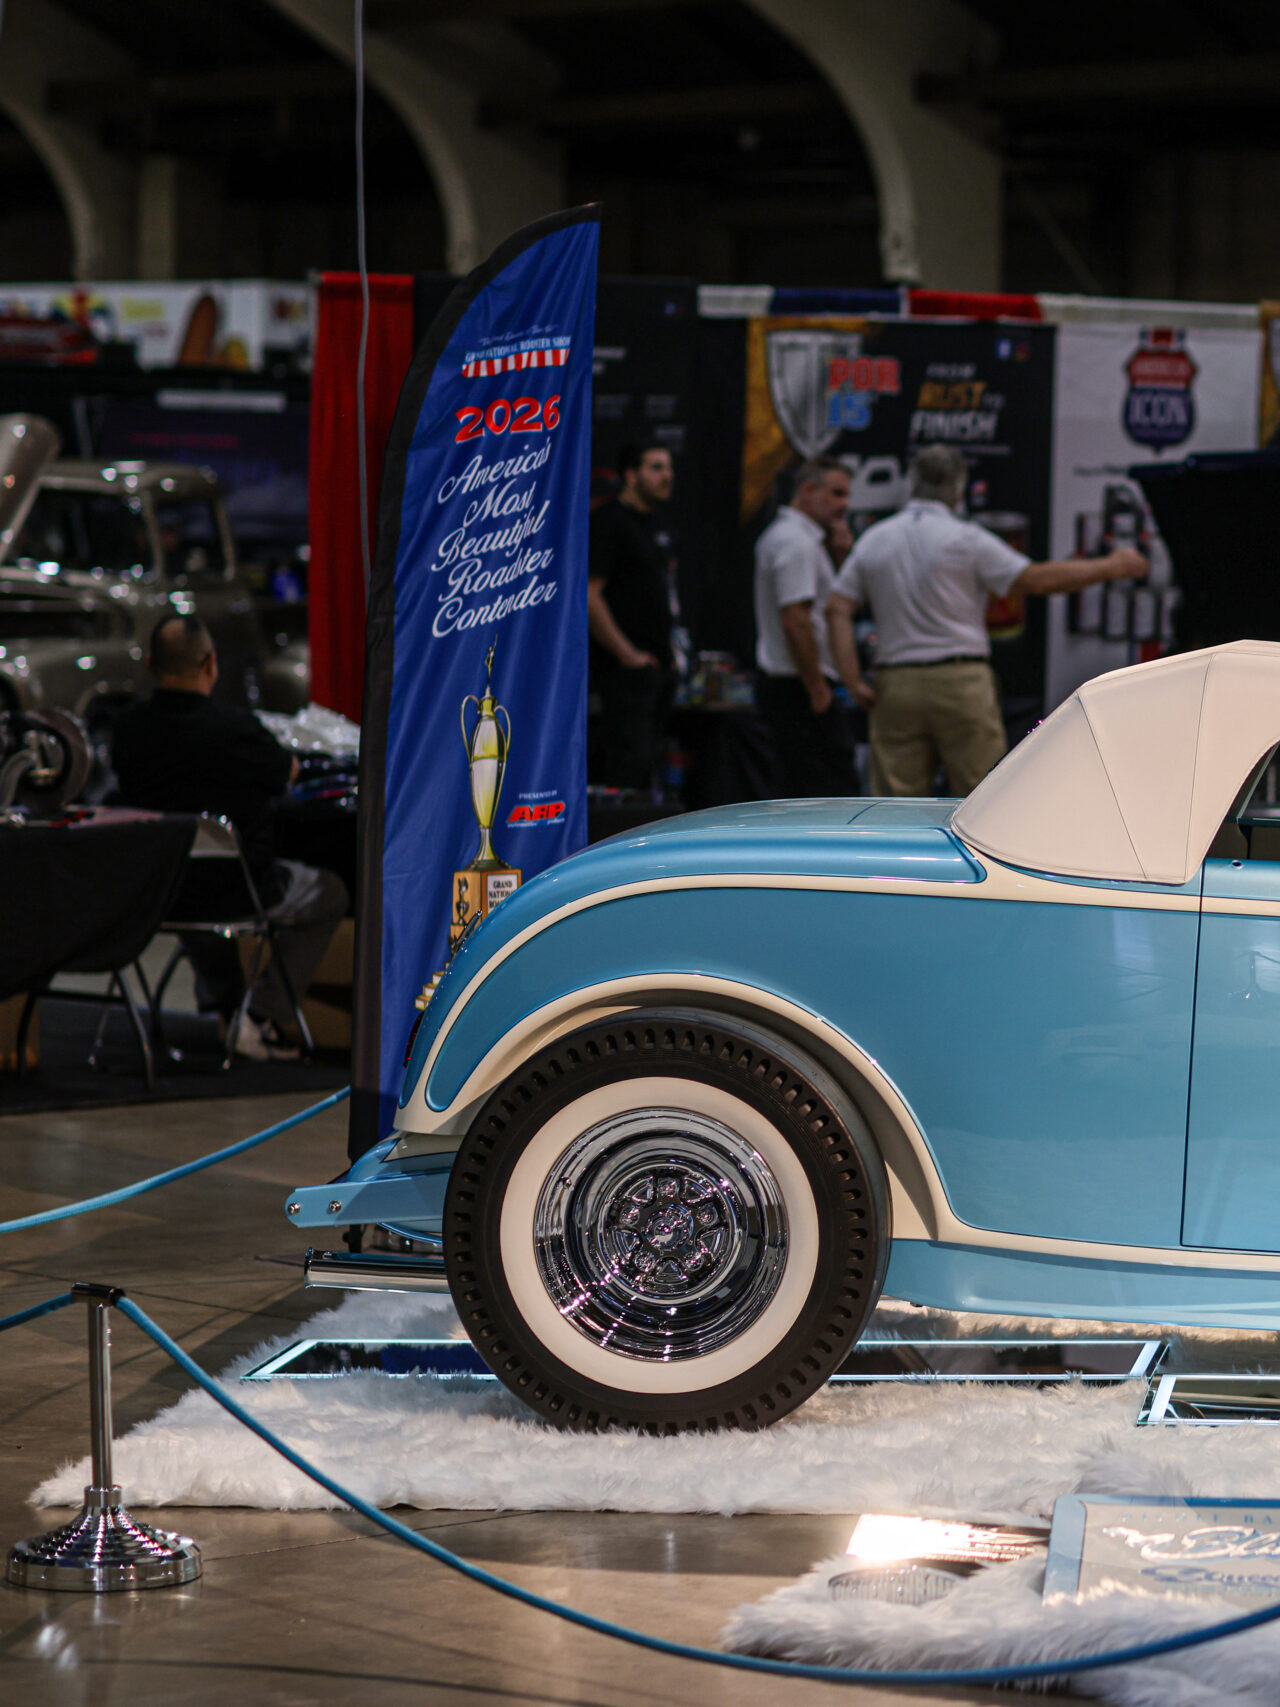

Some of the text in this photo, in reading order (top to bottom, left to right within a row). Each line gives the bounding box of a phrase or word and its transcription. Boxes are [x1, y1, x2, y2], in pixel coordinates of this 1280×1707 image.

[552, 335, 572, 347] SHOW
[829, 356, 901, 394] POR
[455, 395, 560, 443] 2026
[910, 410, 999, 440] FINISH
[438, 437, 551, 504] America's
[463, 479, 537, 528] Most
[431, 500, 550, 572] Beautiful
[439, 548, 554, 603] Roadster
[432, 575, 557, 638] Contender
[508, 803, 565, 823] ARP
[493, 880, 513, 889] GRAND
